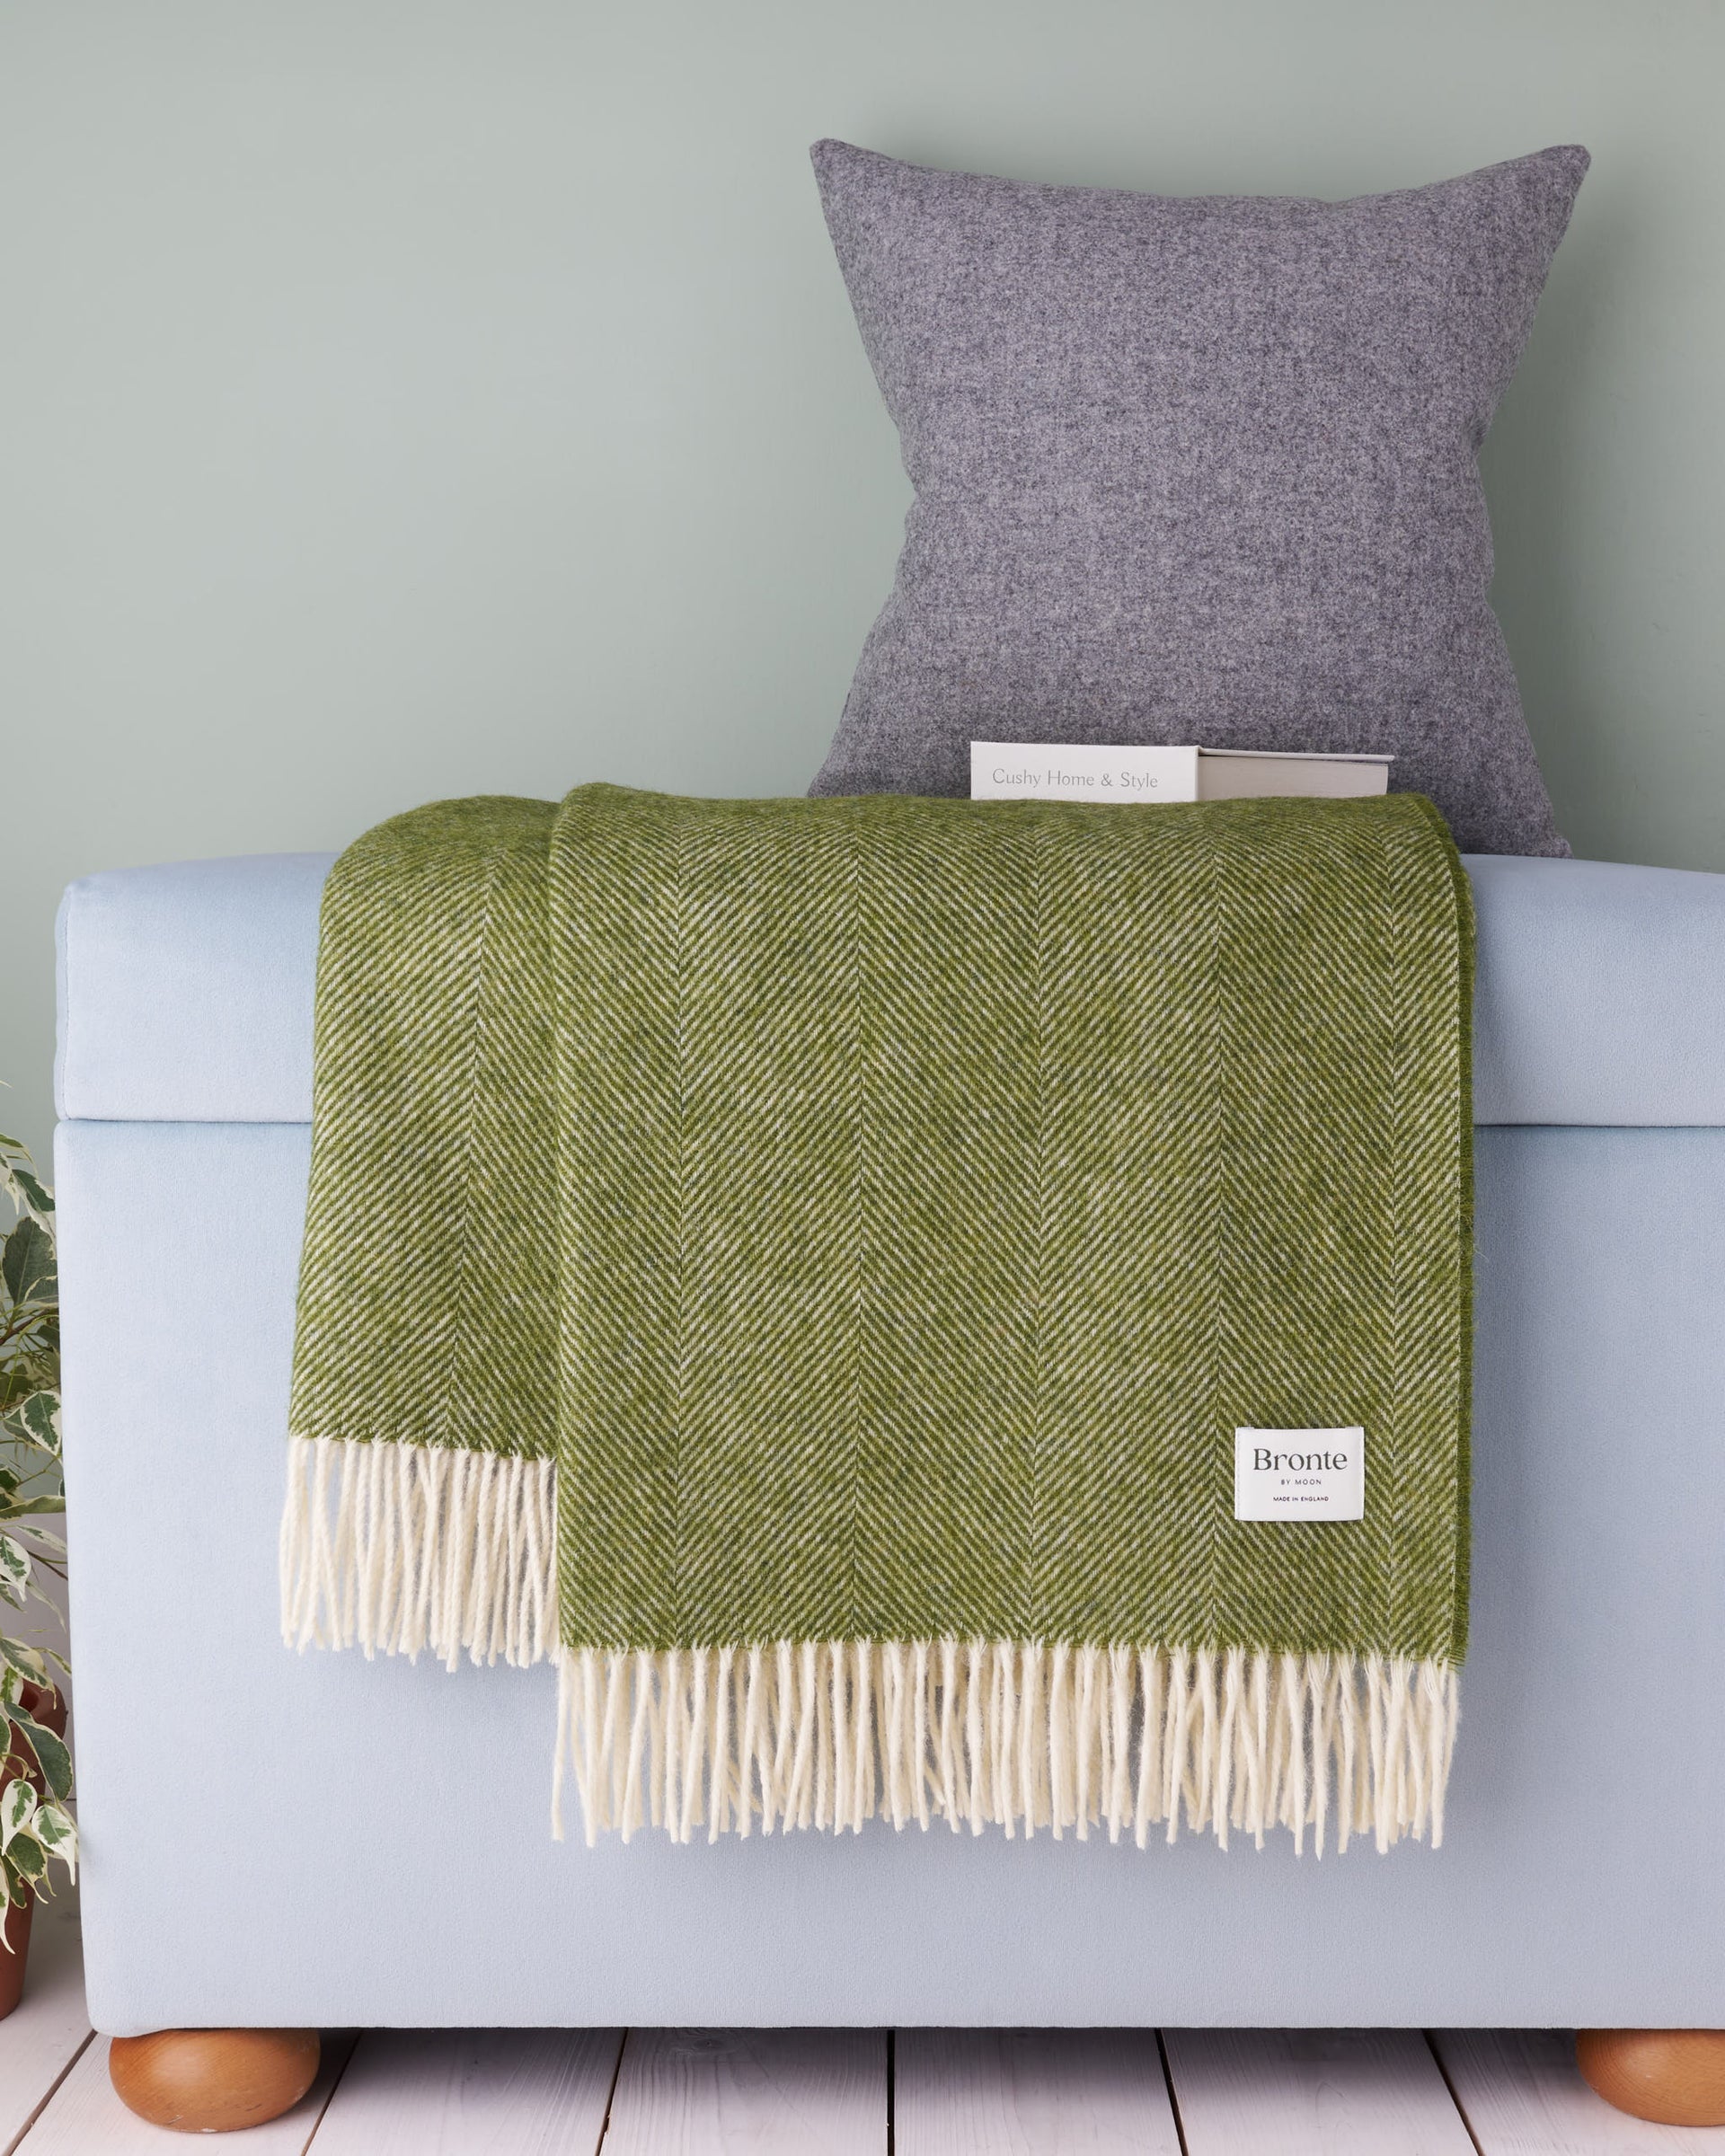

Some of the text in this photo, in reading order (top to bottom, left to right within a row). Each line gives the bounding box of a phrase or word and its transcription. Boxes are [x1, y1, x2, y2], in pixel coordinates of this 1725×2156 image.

[992, 768, 1158, 791] Cushy Home & Style
[1253, 1448, 1348, 1471] Bronte
